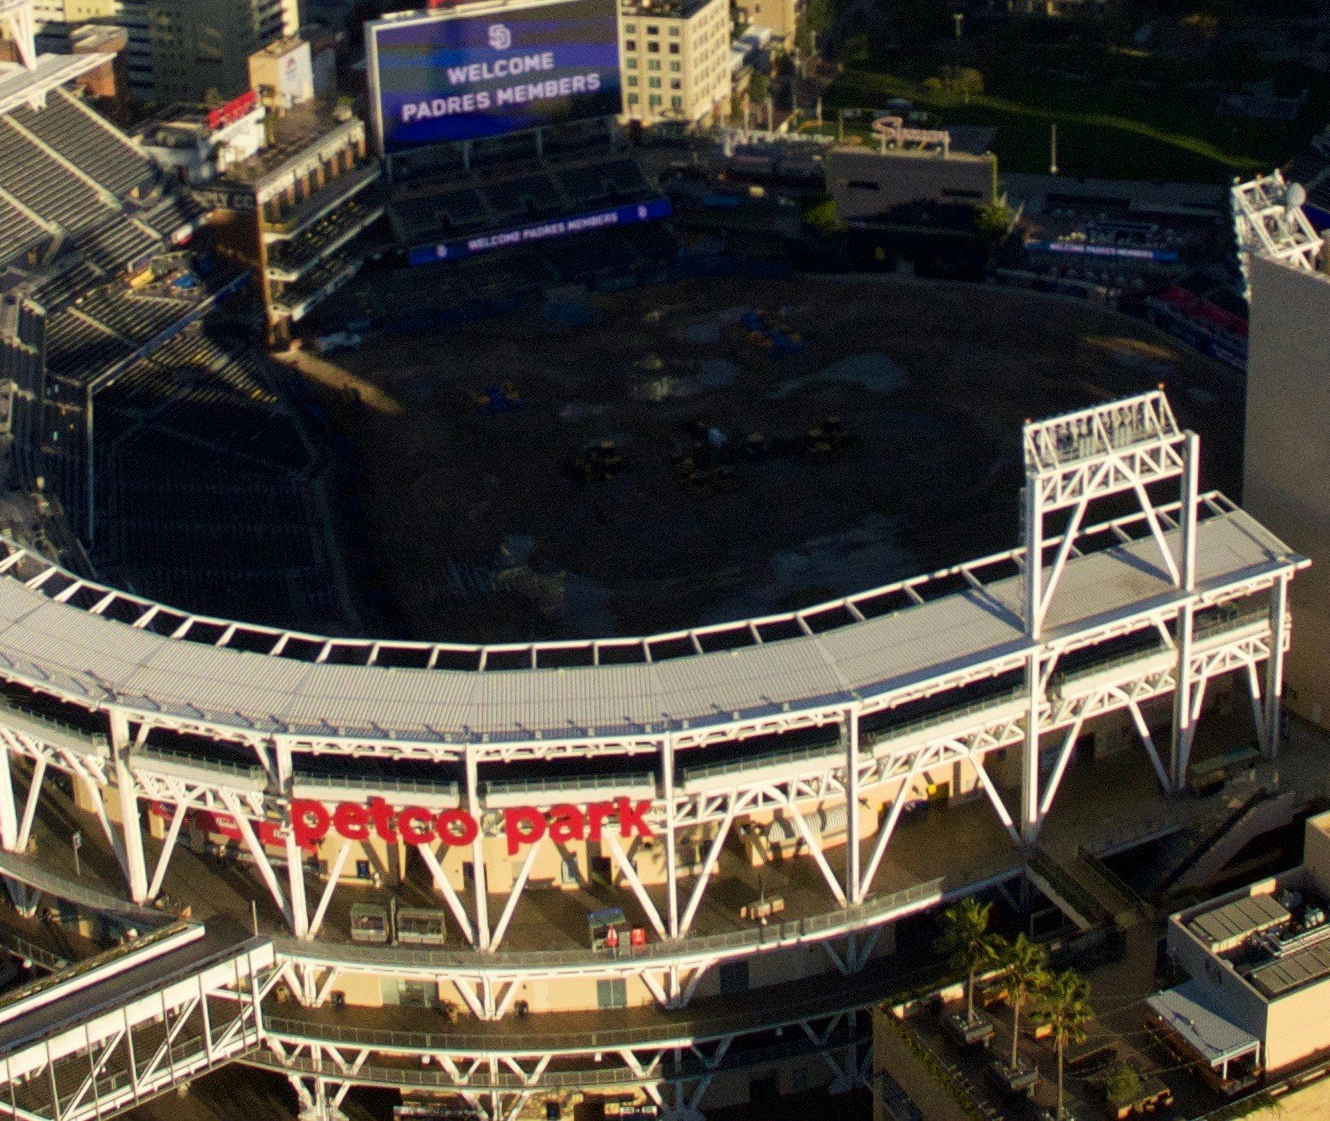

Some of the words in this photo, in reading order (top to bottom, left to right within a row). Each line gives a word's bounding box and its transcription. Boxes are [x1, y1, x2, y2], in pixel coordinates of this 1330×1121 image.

[447, 51, 555, 85] WELCOME
[402, 93, 492, 123] PADRES
[495, 73, 602, 107] MEMBERS
[466, 229, 520, 251] WELCOME
[522, 221, 565, 244] PADRES
[567, 211, 619, 233] MEMBERS
[290, 797, 480, 854] petco
[504, 796, 655, 856] park
